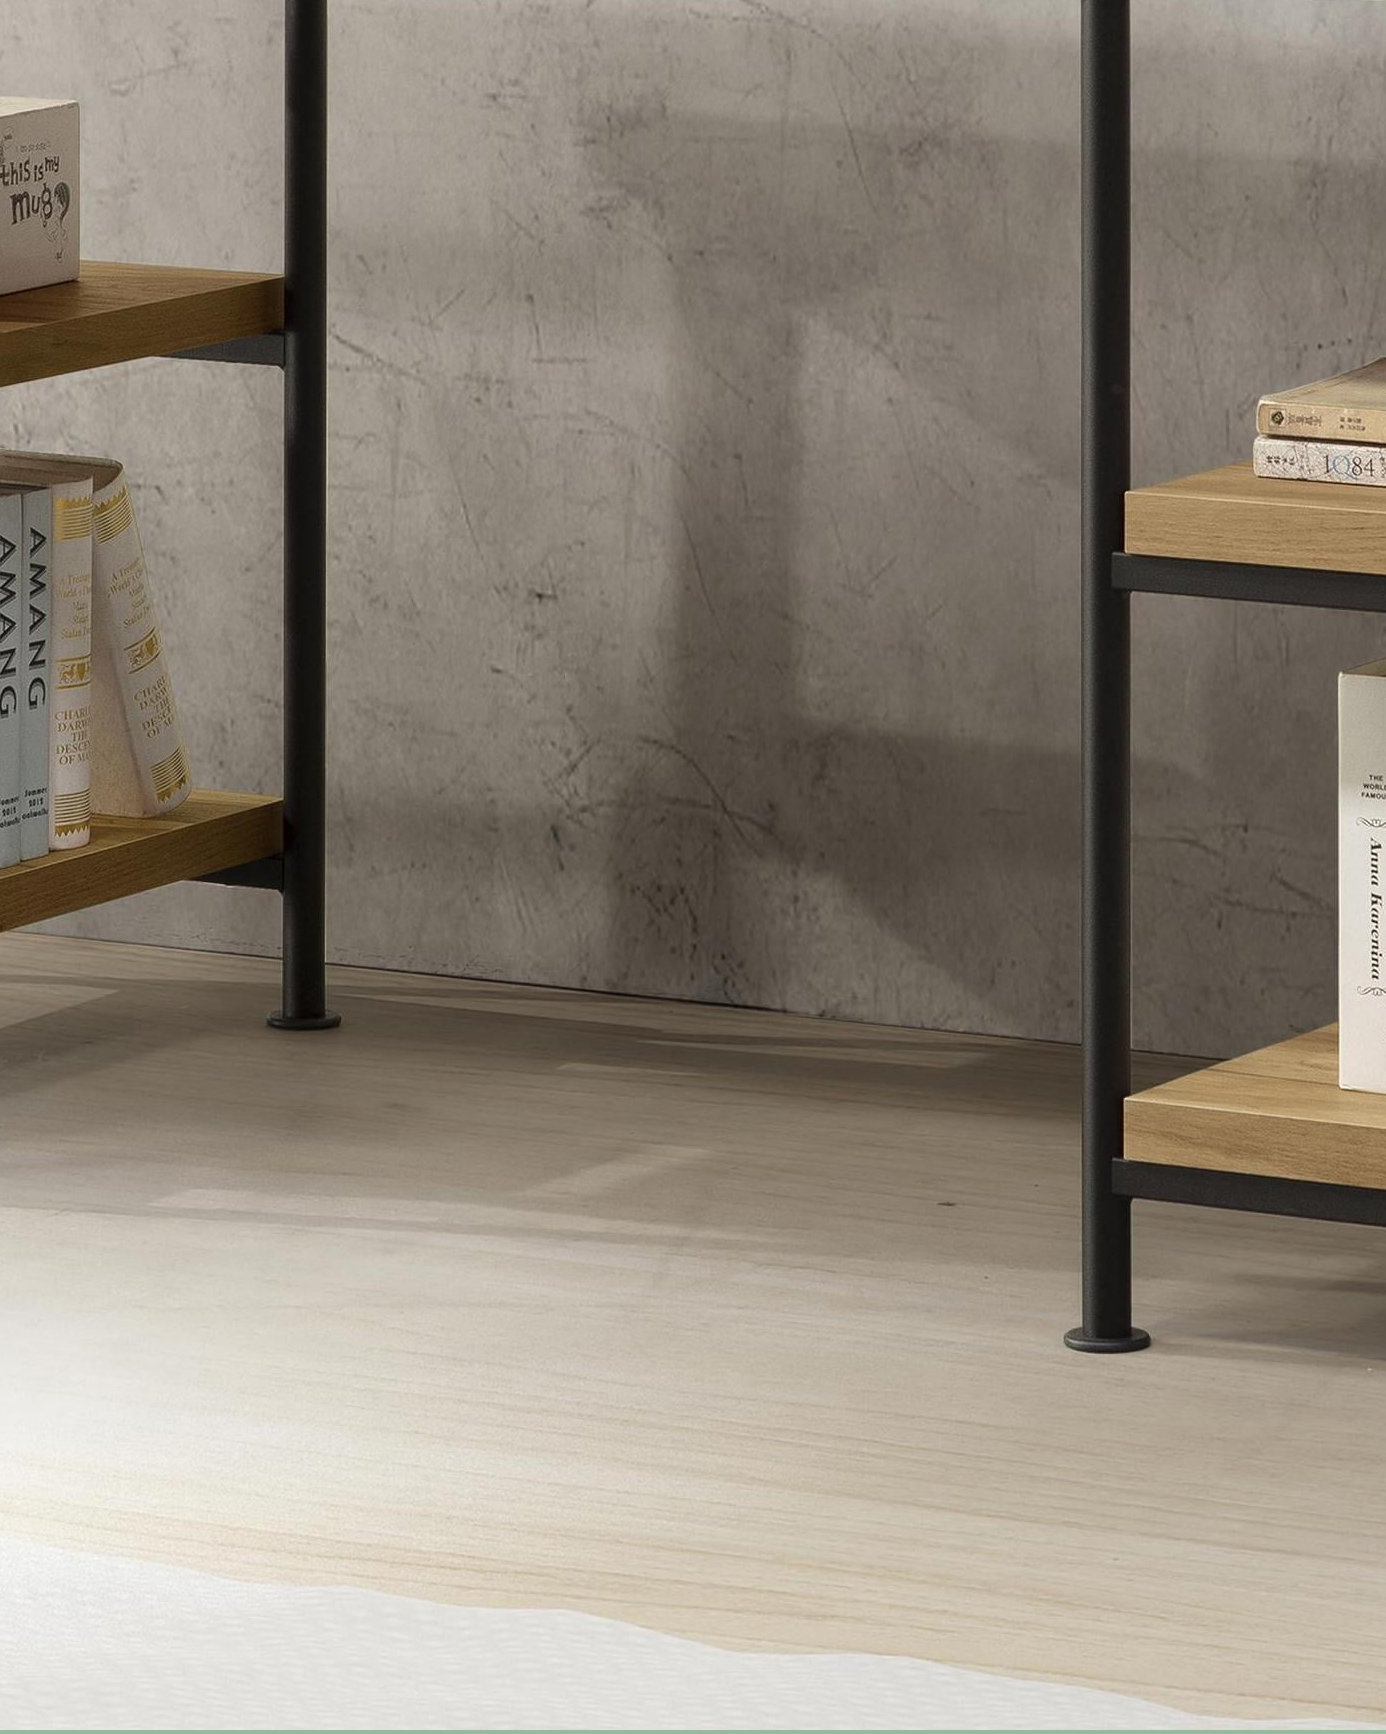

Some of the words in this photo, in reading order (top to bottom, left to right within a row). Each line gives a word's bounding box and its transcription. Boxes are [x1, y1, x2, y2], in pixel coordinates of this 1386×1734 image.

[34, 163, 44, 182] is
[45, 156, 59, 173] my
[1323, 454, 1376, 480] 1Q84
[0, 535, 17, 719] AMANG
[28, 527, 47, 710] AMANG
[1369, 774, 1384, 782] THE
[1370, 837, 1382, 886] Anna
[1370, 892, 1383, 980] Karenina
